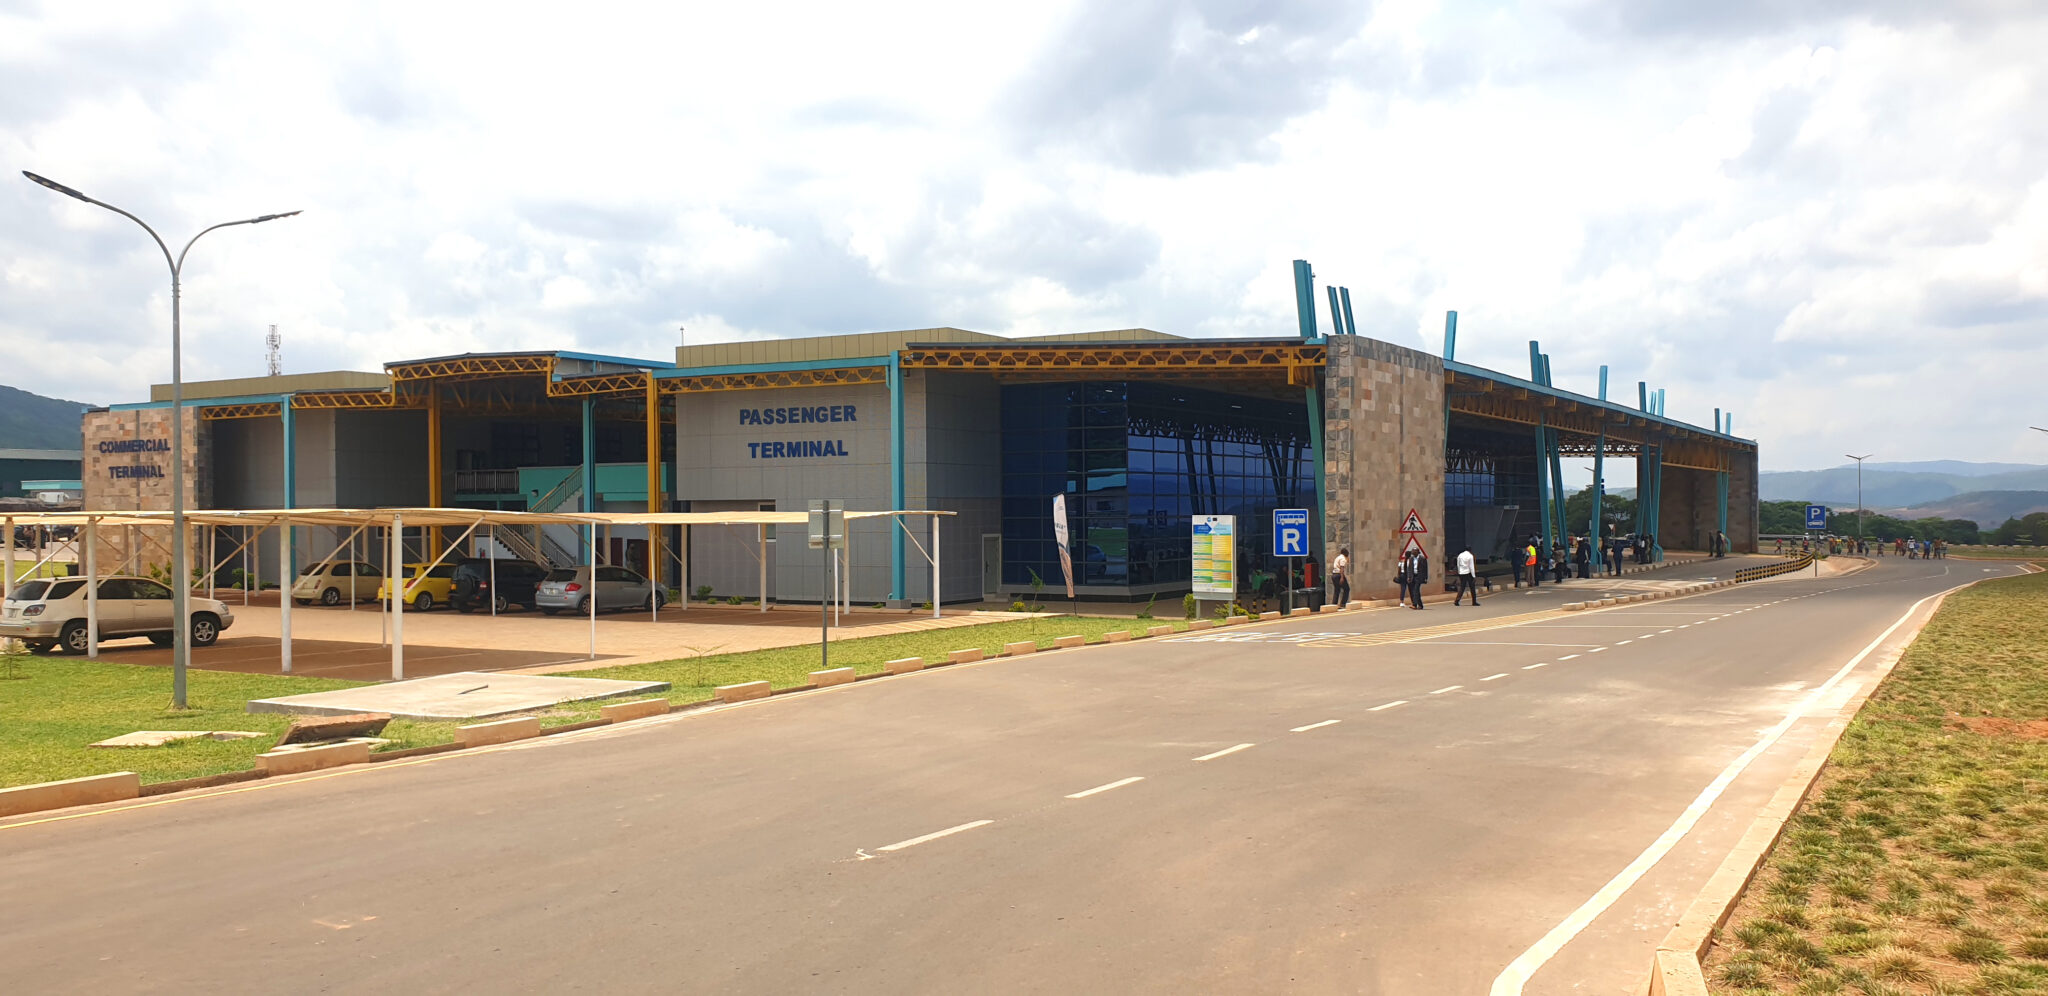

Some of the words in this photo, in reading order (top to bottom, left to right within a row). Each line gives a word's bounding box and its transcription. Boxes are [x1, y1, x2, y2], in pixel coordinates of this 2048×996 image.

[740, 405, 857, 425] PASSENGER
[99, 439, 171, 453] COMMERCIAL
[748, 440, 848, 458] TERMINAL
[108, 465, 165, 479] TERMINAL
[1811, 508, 1821, 519] P
[1282, 528, 1300, 552] R
